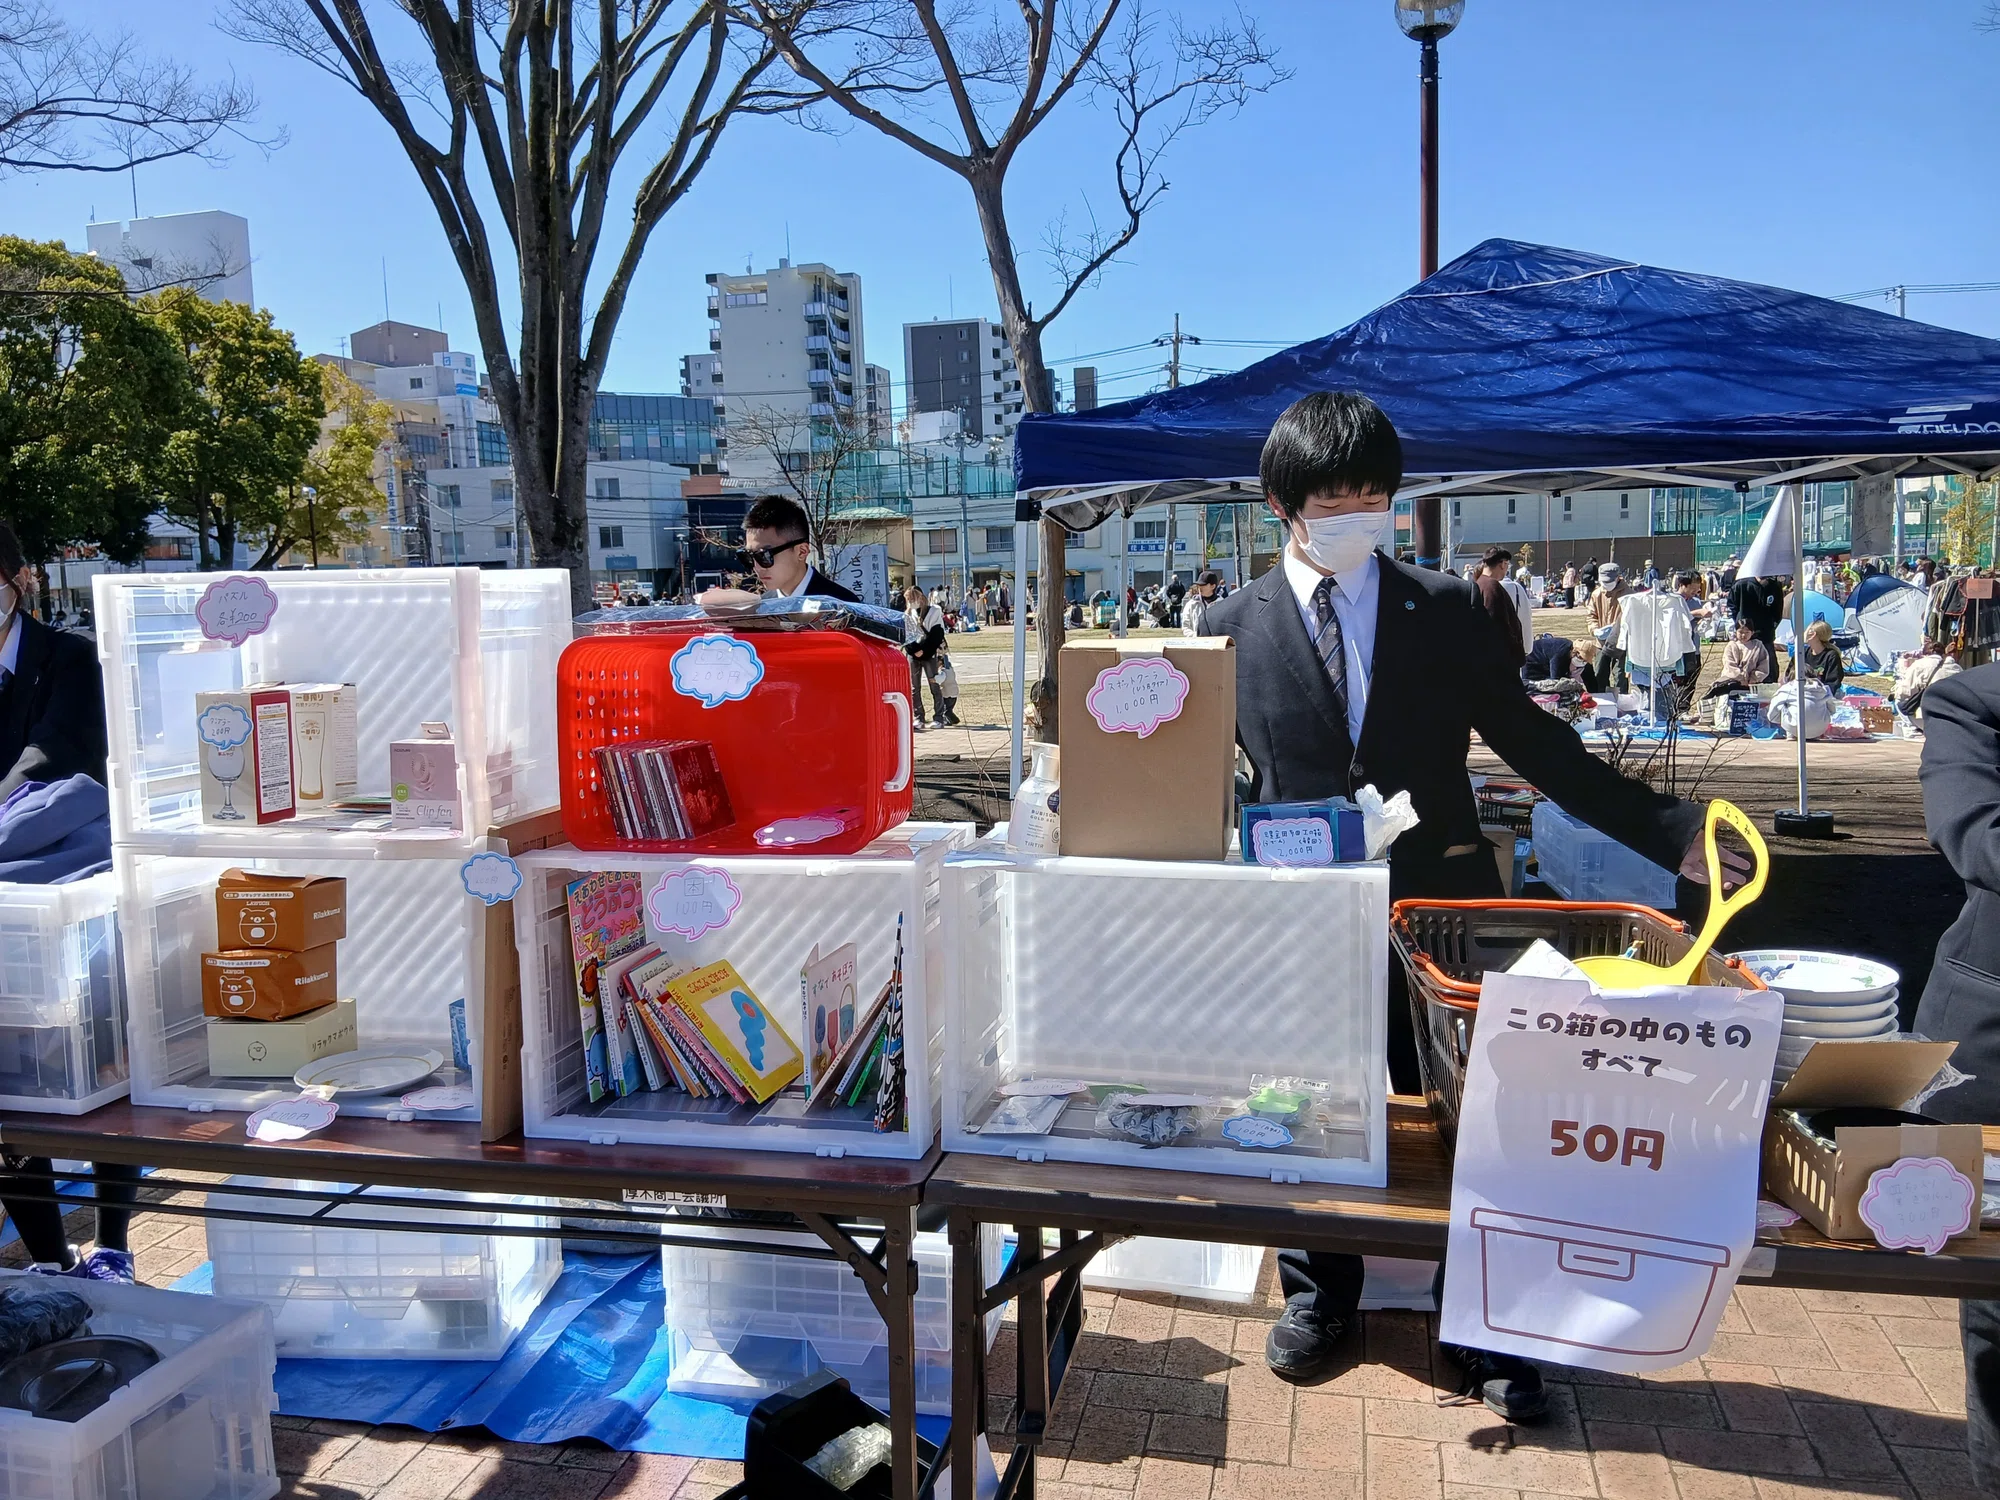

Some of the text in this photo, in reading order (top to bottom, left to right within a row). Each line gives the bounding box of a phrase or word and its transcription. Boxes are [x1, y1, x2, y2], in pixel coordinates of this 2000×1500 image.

[218, 591, 249, 604] パズル
[691, 670, 741, 684] 200円
[416, 804, 435, 819] Clip
[435, 804, 453, 819] fan
[313, 907, 341, 921] Rilakkuma
[580, 883, 637, 931] どうぶつ
[676, 900, 713, 915] 100円
[294, 971, 329, 986] Rilakkuma
[811, 961, 854, 997] すなで あそぼう
[311, 1024, 354, 1053] リラックマボウル
[1507, 1008, 1752, 1048] この箱の中のもの
[1581, 1048, 1663, 1078] すべて
[1550, 1119, 1666, 1172] 50円
